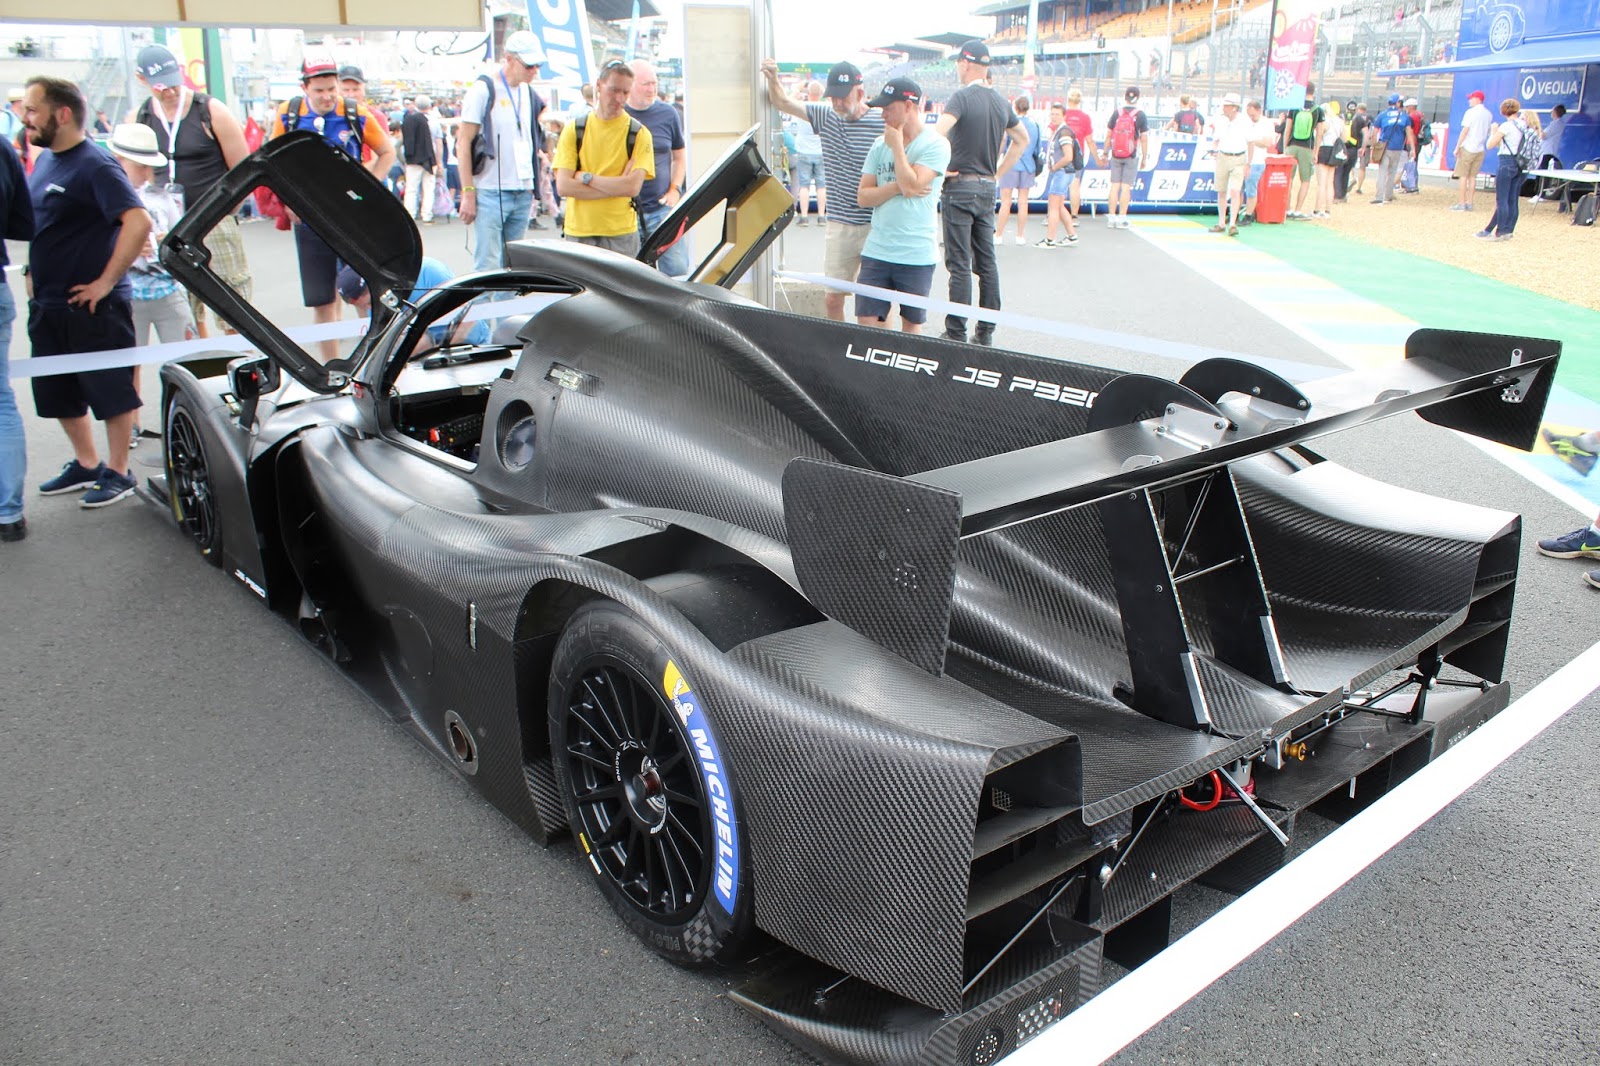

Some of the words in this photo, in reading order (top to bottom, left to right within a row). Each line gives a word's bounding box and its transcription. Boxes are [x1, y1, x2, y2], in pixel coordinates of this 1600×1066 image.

[838, 74, 850, 83] 43
[884, 85, 895, 94] 43
[1537, 81, 1578, 95] VEOLIA
[845, 343, 939, 377] LIGIER
[952, 366, 1002, 389] JS
[690, 728, 733, 899] MICHELIN
